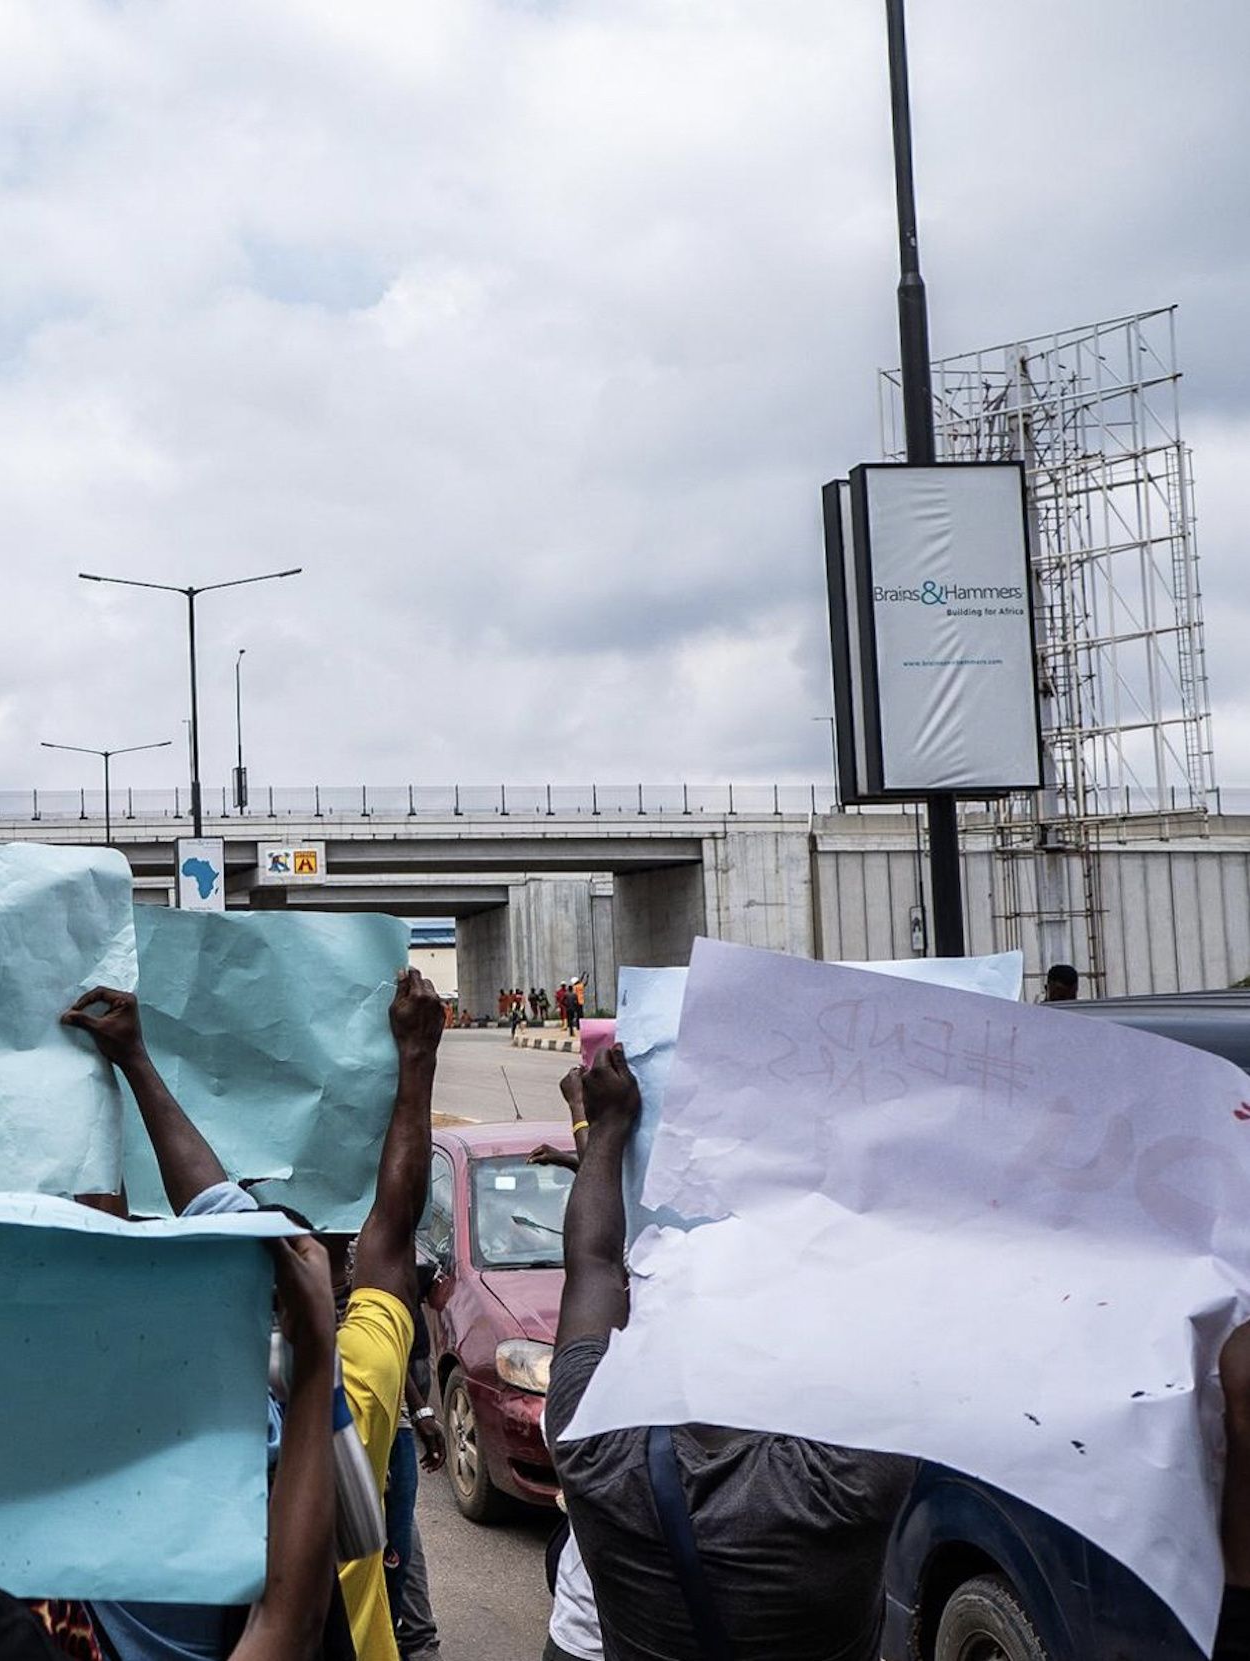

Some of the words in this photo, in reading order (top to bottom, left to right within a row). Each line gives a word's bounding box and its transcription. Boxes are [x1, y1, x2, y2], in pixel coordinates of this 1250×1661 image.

[947, 608, 982, 617] Building
[984, 608, 997, 616] for
[998, 607, 1024, 615] Africa
